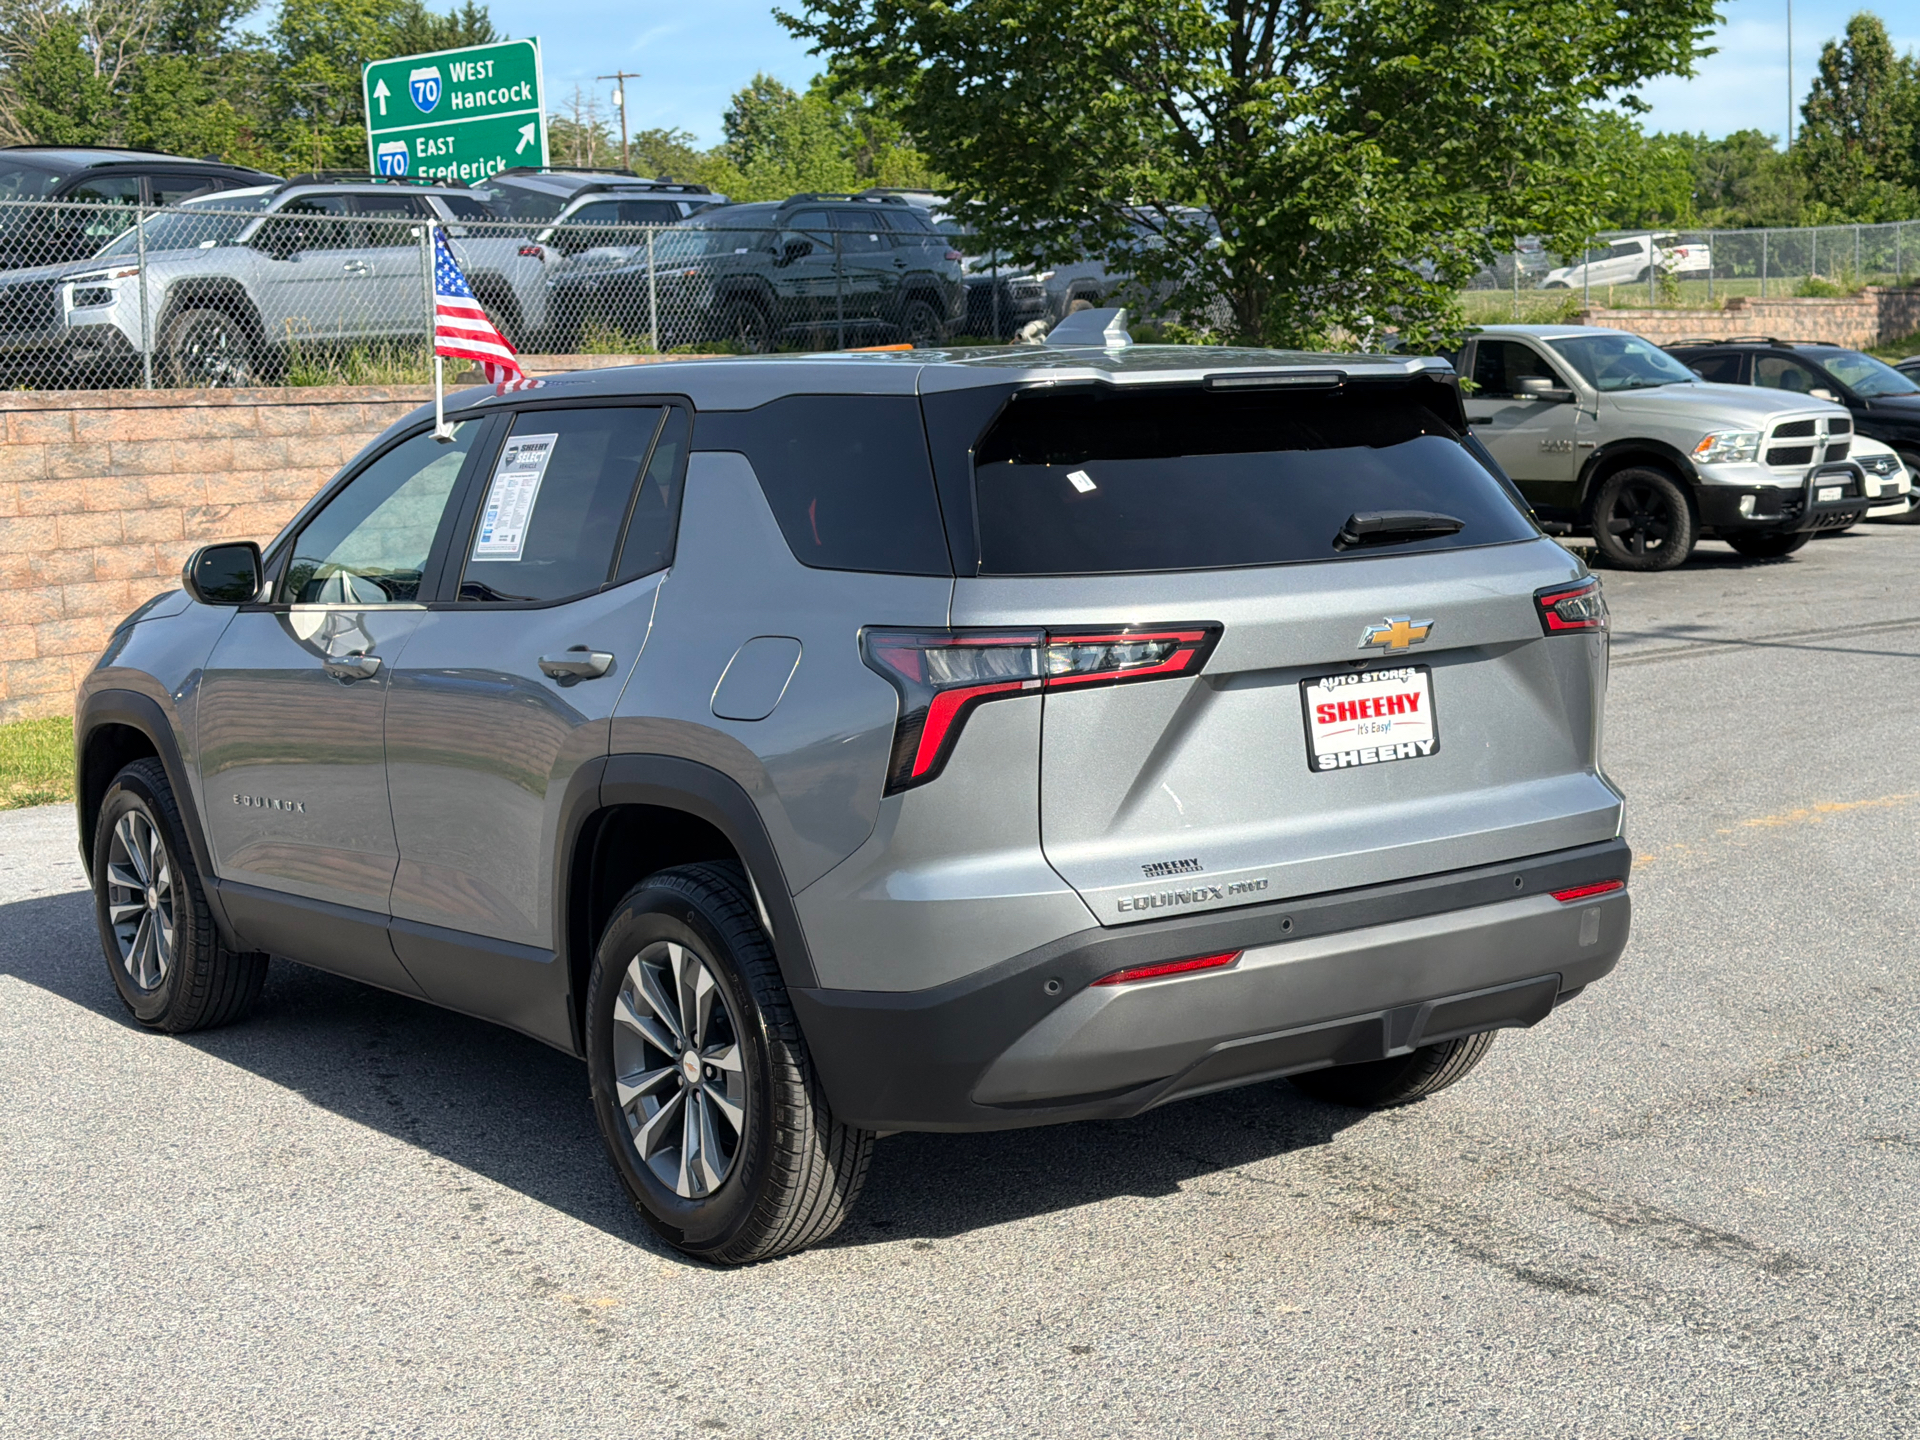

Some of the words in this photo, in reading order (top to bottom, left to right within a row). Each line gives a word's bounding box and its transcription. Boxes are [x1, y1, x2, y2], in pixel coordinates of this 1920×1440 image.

[449, 60, 495, 83] WEST
[414, 80, 438, 104] 70
[451, 80, 532, 110] Hancock
[416, 136, 455, 157] EAST
[382, 154, 405, 176] 70
[516, 451, 546, 463] SELECT
[521, 443, 549, 452] SHEEHY
[1318, 674, 1359, 688] AUTO
[1362, 667, 1416, 683] STORES
[1316, 691, 1421, 725] SHEEHY
[1357, 723, 1369, 735] It's
[1371, 720, 1392, 735] Easy!
[1318, 739, 1435, 770] SHEEHY
[232, 794, 305, 813] EQUINOX
[1141, 858, 1198, 873] SHEEHY
[1117, 884, 1224, 912] EQUINOX
[1228, 877, 1269, 896] AWD
